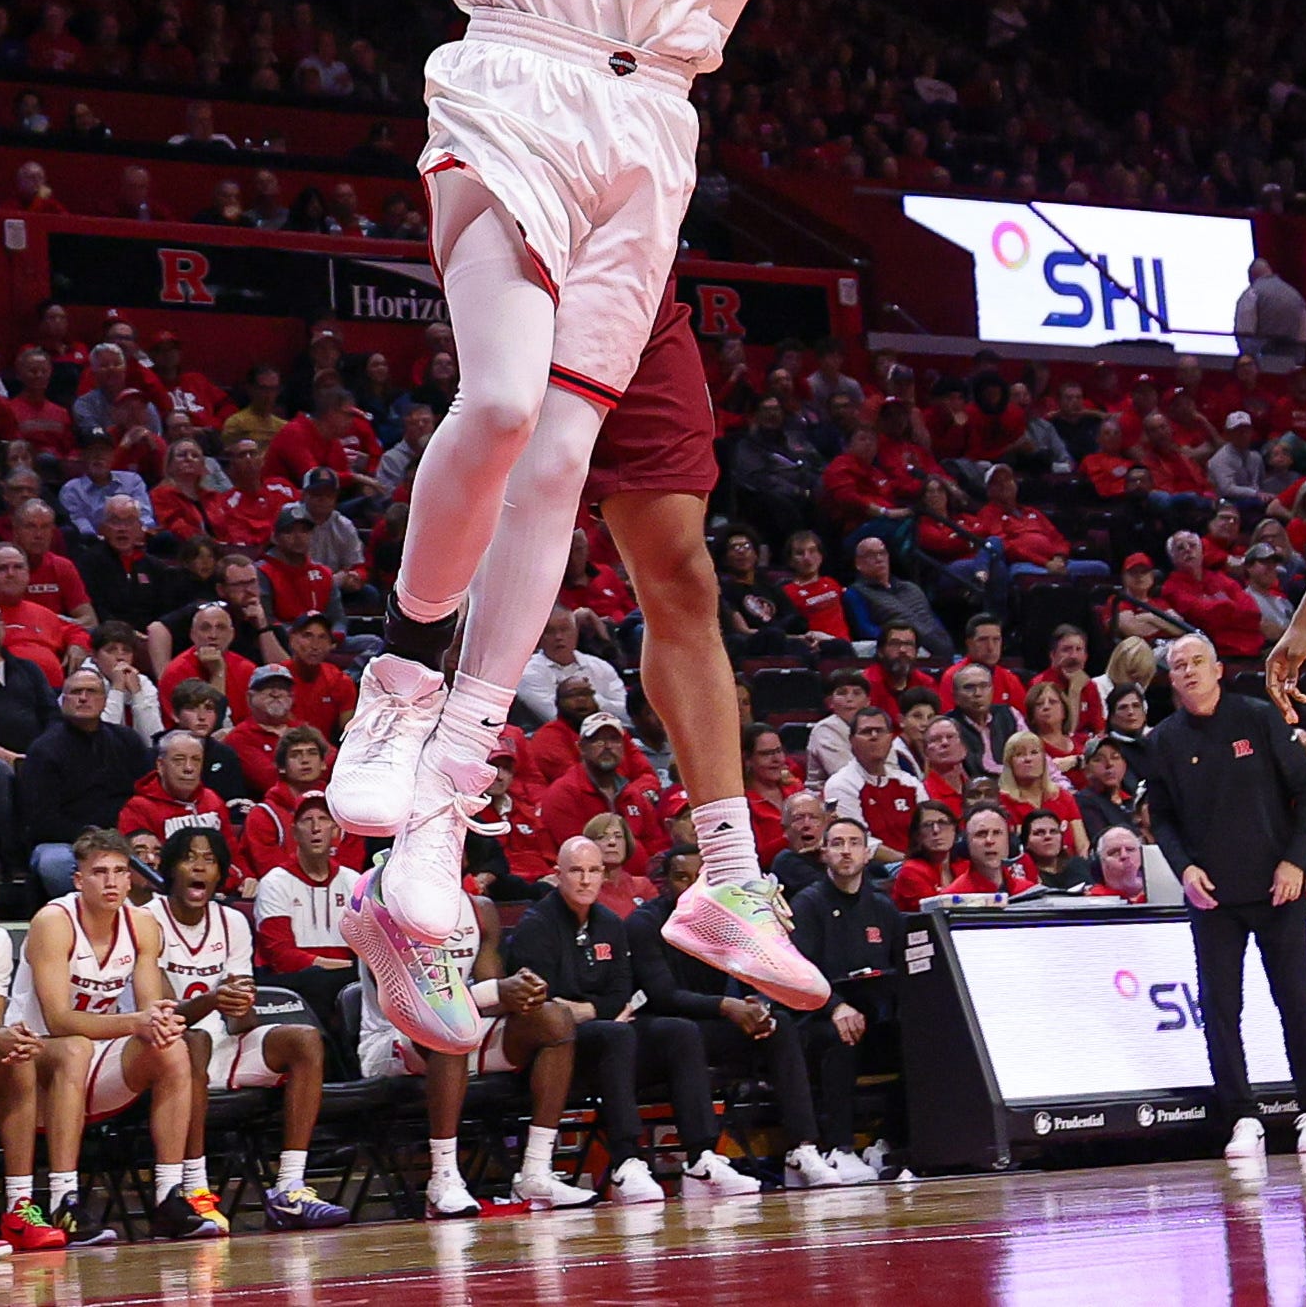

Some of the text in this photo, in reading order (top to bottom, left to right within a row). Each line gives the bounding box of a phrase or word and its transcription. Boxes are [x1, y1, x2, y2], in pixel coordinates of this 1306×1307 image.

[157, 248, 214, 305] R
[1042, 251, 1170, 333] SHI
[351, 285, 450, 321] Horizo
[696, 285, 746, 335] R
[251, 999, 305, 1015] rudential
[1053, 1113, 1105, 1131] Prudential
[1156, 1105, 1207, 1124] Prudential
